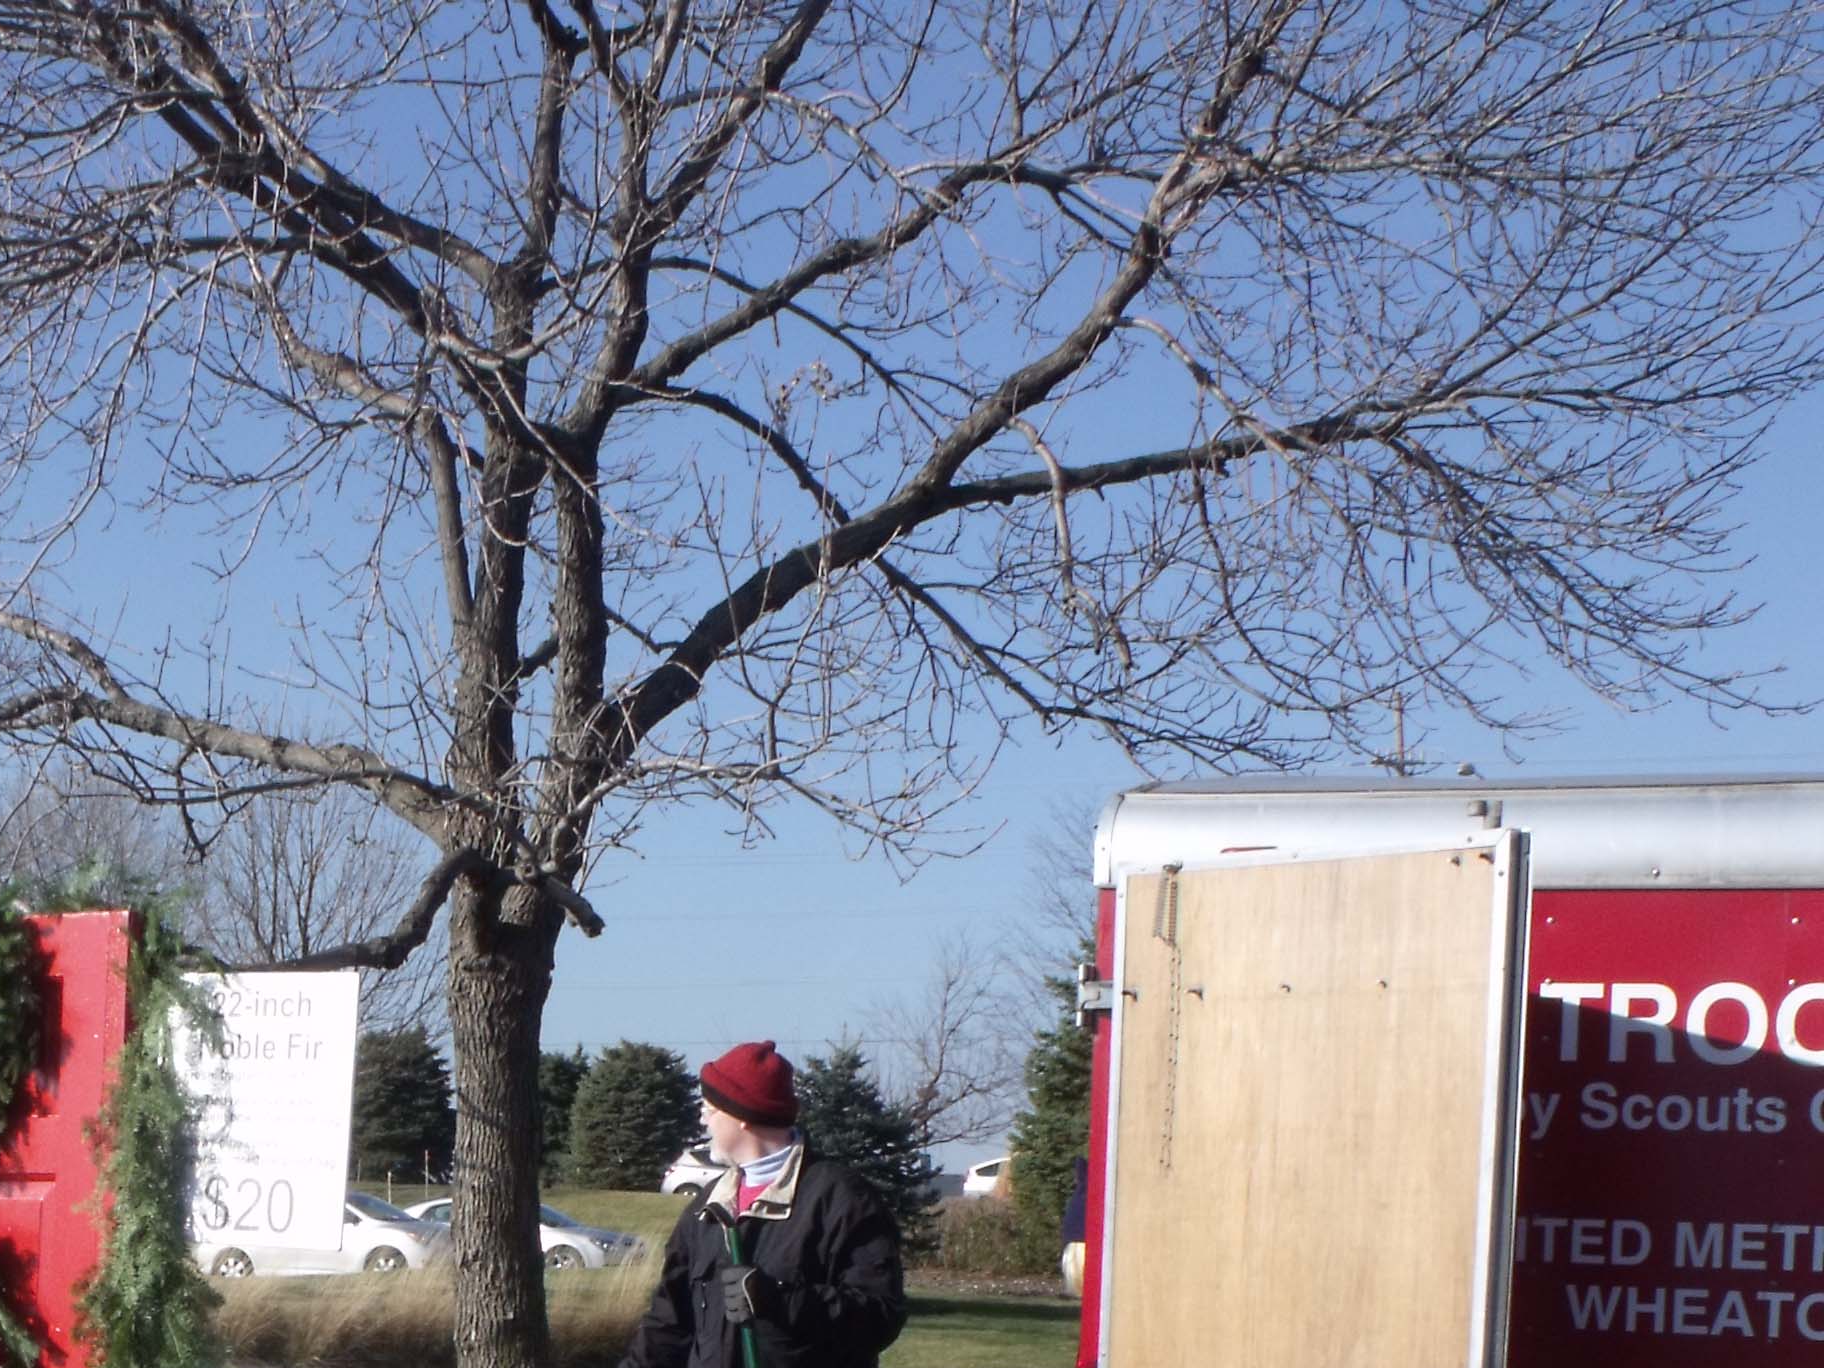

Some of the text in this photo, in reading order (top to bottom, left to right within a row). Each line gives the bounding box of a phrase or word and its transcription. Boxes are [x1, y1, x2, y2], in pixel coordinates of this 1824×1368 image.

[288, 1033, 324, 1061] Fir
[1580, 1081, 1788, 1134] Scouts
[201, 1175, 294, 1233] $20
[1676, 1221, 1824, 1273] MET
